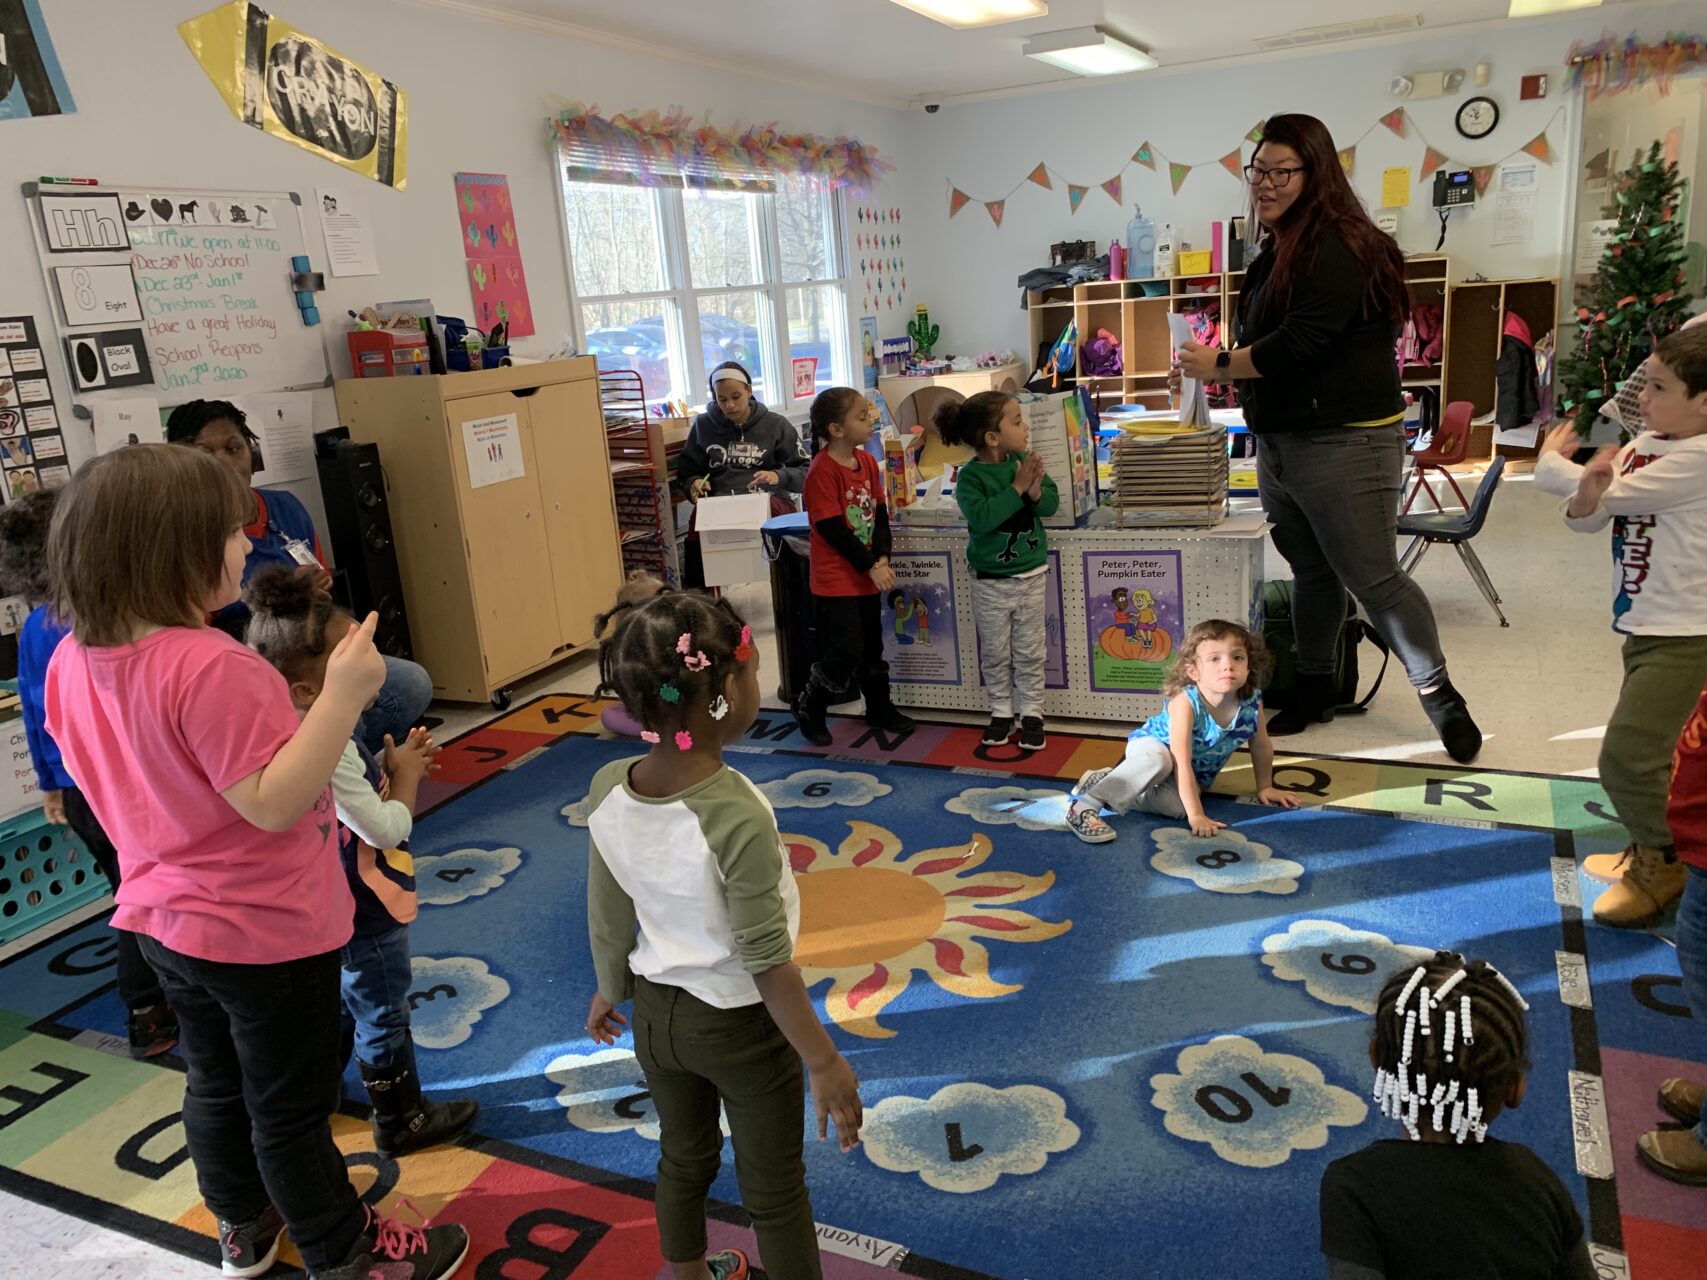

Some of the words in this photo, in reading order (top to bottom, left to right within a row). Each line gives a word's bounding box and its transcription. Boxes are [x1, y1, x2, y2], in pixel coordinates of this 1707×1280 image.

[272, 65, 375, 135] CRAYON
[203, 237, 232, 252] open
[238, 234, 252, 249] at
[184, 252, 203, 269] No
[204, 253, 250, 268] School
[72, 267, 97, 311] 8
[143, 276, 169, 292] Dec
[104, 301, 128, 312] Eight
[146, 296, 215, 315] Christmas
[219, 294, 258, 310] Break
[147, 318, 180, 337] Have
[187, 319, 196, 331] a
[202, 314, 230, 339] great
[236, 314, 277, 339] Holiday
[107, 346, 131, 357] Black
[155, 344, 202, 367] School
[209, 340, 263, 361] Reopens
[111, 362, 131, 372] Oval
[160, 368, 189, 391] Jan
[213, 365, 247, 382] 2020
[911, 561, 943, 569] Twinkle,
[913, 570, 930, 578] Star
[1098, 570, 1139, 579] Pumpkin
[1141, 570, 1167, 578] Eater
[1102, 560, 1131, 569] Peter,
[1132, 560, 1162, 569] Peter,
[541, 702, 598, 724] K
[848, 728, 915, 751] N
[463, 745, 508, 763] J
[802, 782, 832, 797] 6
[1271, 765, 1332, 798] Q
[1424, 777, 1499, 812] R
[1195, 849, 1242, 871] 8
[435, 866, 477, 884] 4
[1194, 1071, 1291, 1123] 10
[474, 1208, 614, 1280] B
[815, 1227, 894, 1260] Aiyan
